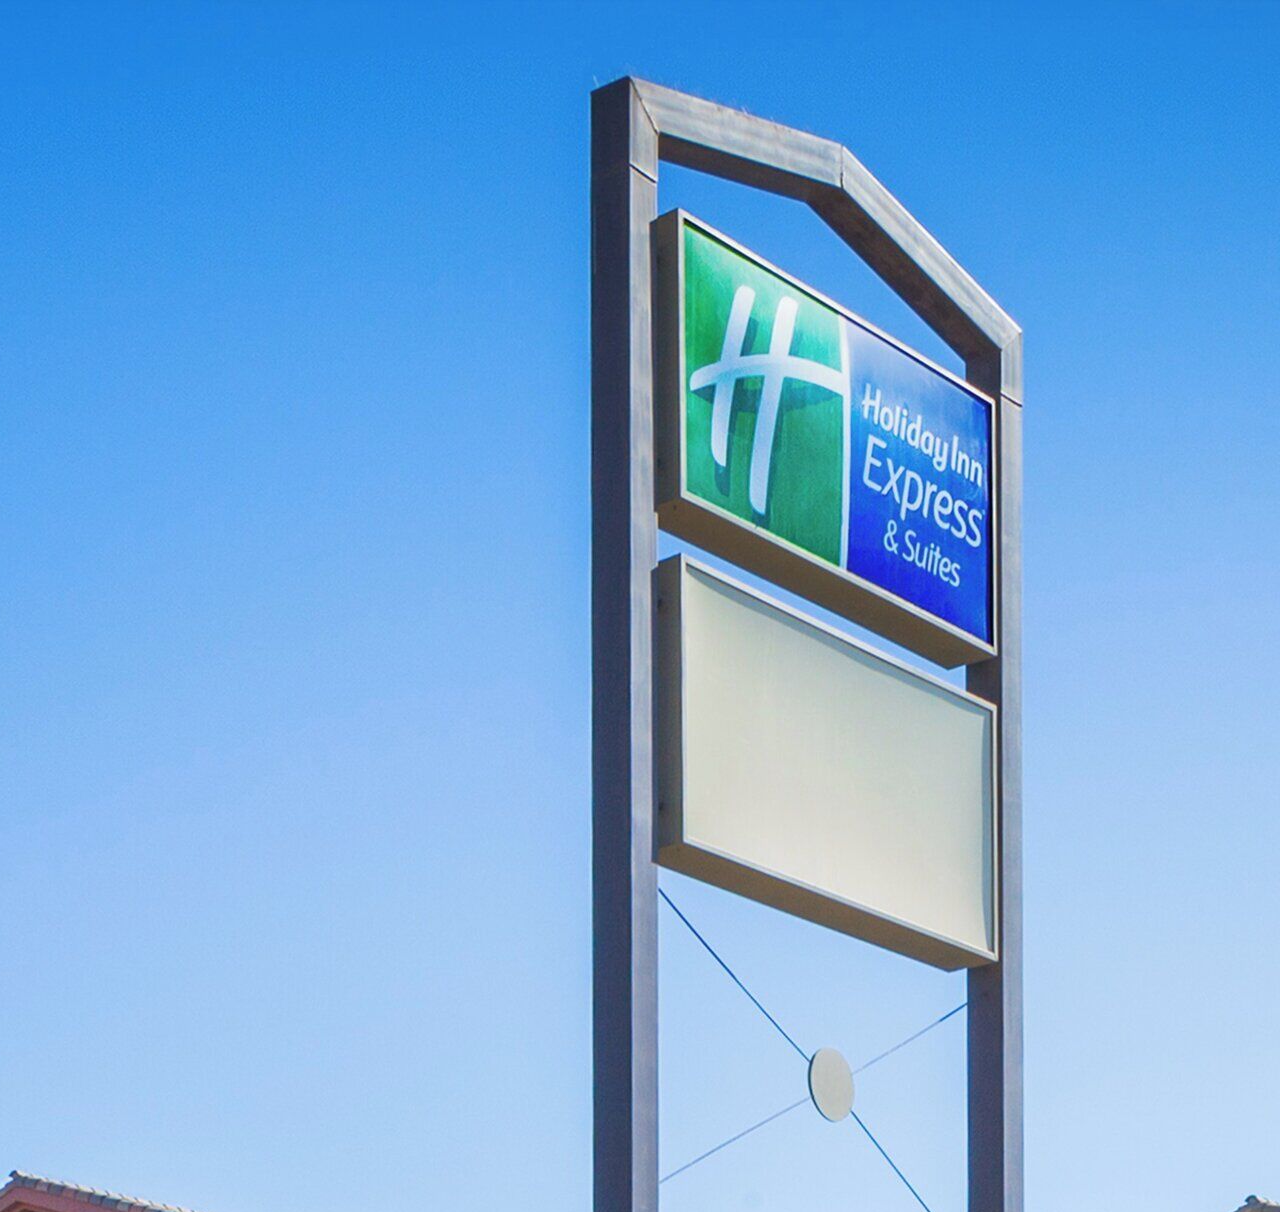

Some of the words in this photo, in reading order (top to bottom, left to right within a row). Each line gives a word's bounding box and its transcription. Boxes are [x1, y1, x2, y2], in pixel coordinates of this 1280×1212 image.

[862, 383, 948, 472] Holiday
[950, 435, 983, 488] Inn
[863, 434, 983, 548] Express
[884, 519, 899, 555] &
[902, 529, 961, 588] Suites
